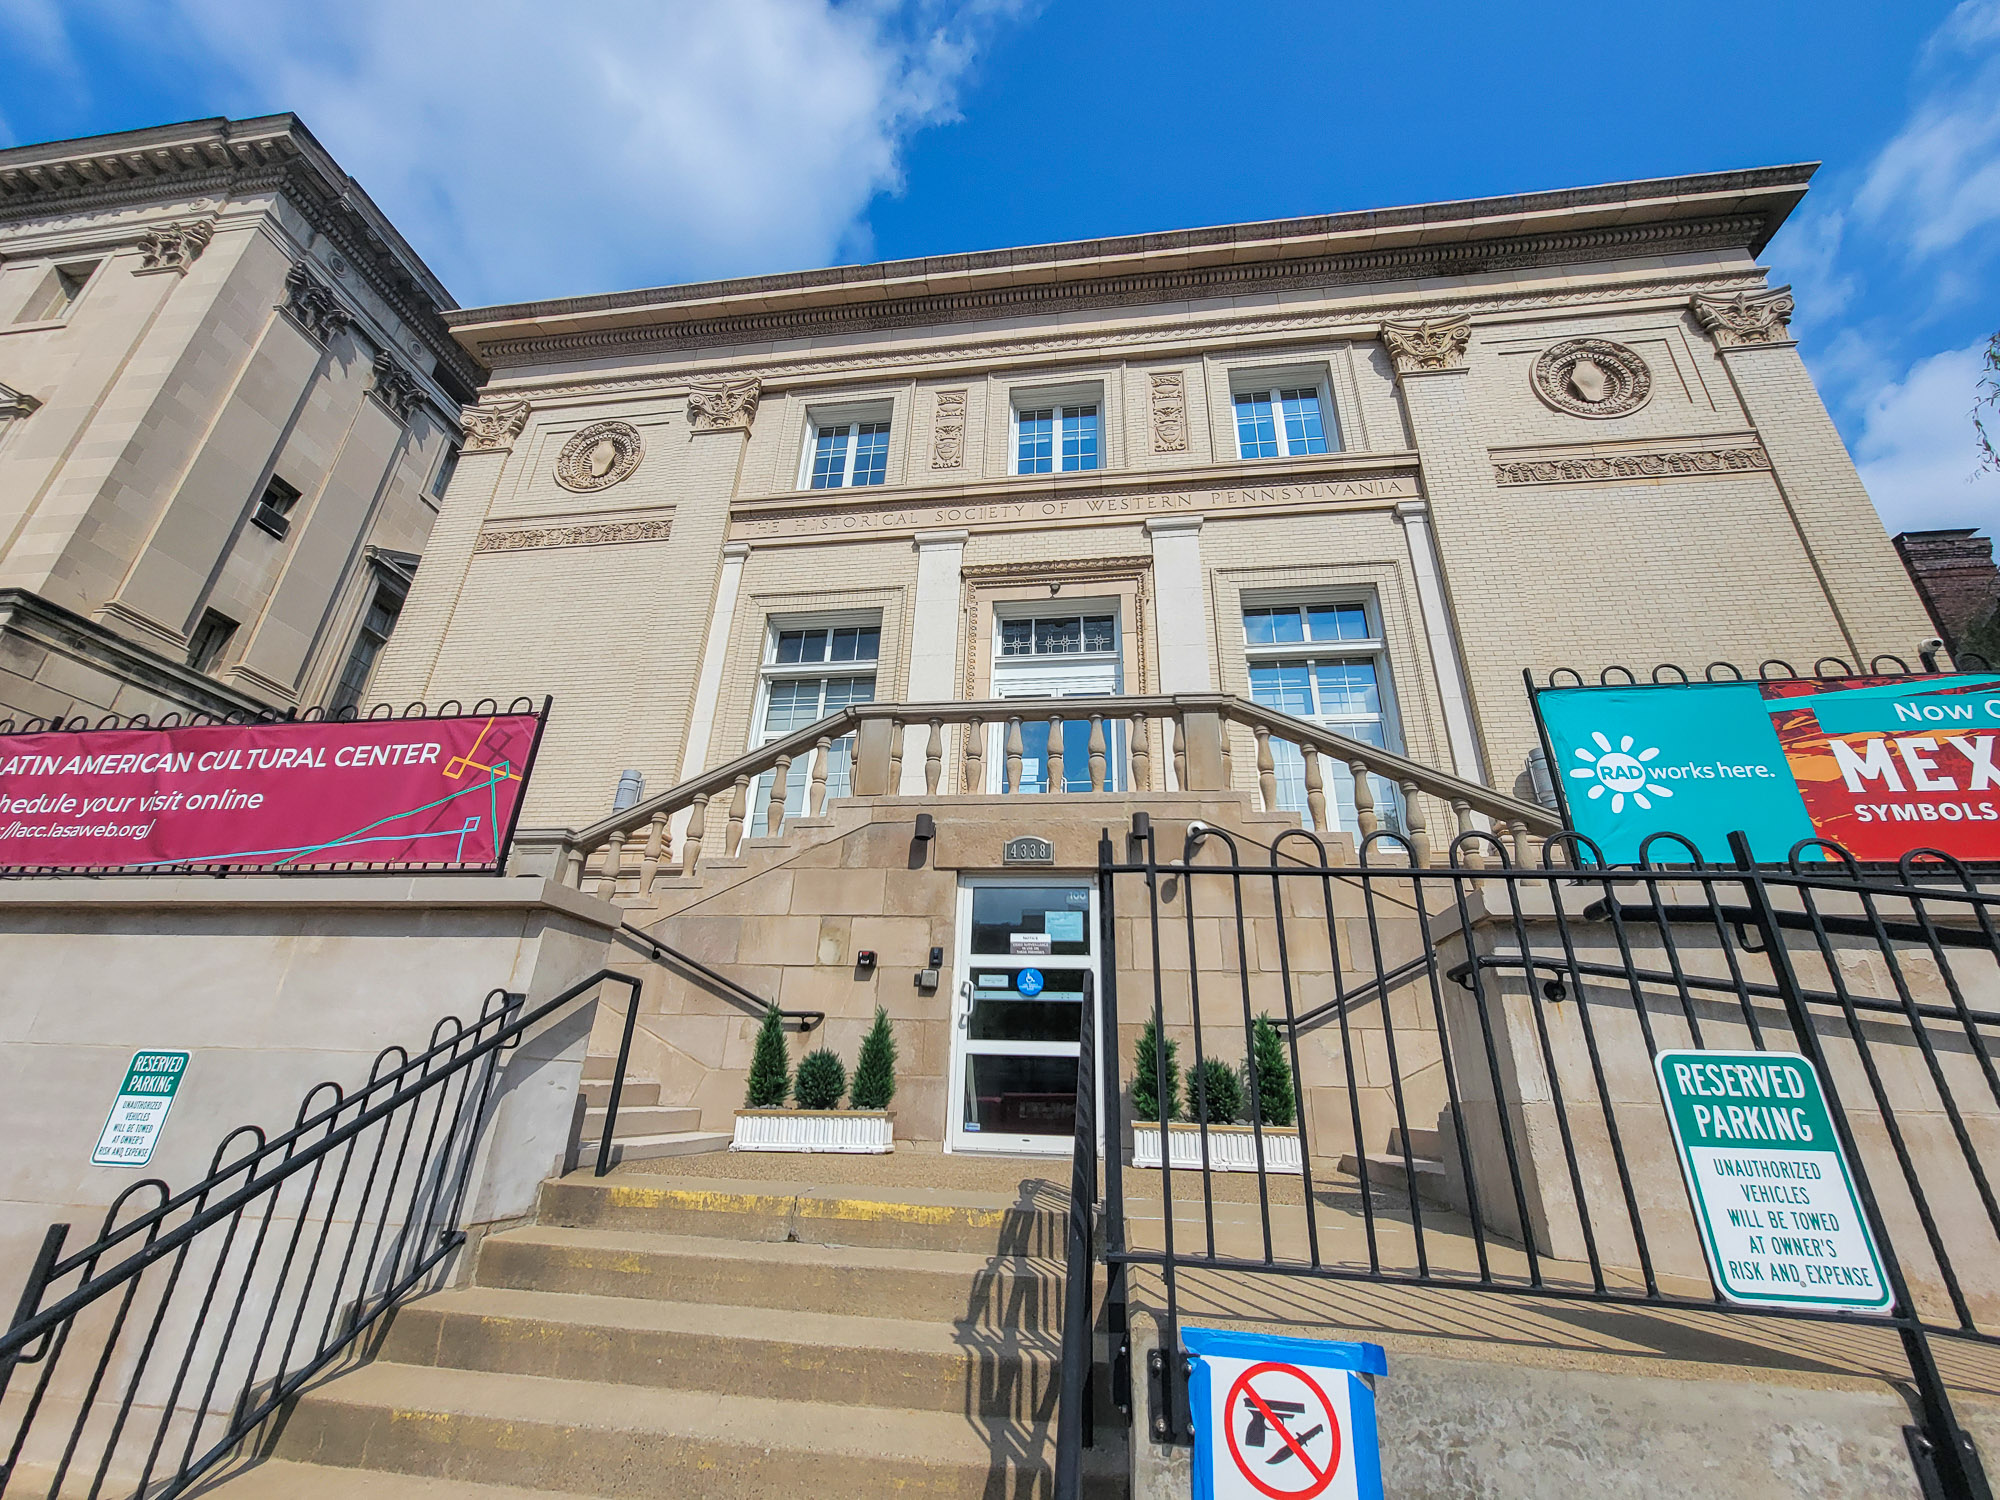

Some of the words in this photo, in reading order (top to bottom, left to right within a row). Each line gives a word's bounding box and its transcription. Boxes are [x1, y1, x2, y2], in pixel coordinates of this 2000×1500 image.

[744, 521, 780, 535] THE
[794, 513, 918, 532] HISTORICAL
[934, 504, 1027, 522] SOCIETY
[1041, 502, 1070, 516] OF
[1085, 494, 1193, 512] WESTERN
[1211, 481, 1404, 505] PENNSYLVANIA
[59, 752, 195, 775] AMERICAN
[197, 747, 327, 772] CULTURAL
[334, 742, 441, 768] CENTER
[1827, 735, 2000, 793] MEX
[1599, 765, 1643, 780] RAD
[1647, 761, 1716, 780] works
[1716, 761, 1776, 779] here.
[75, 796, 136, 818] your
[138, 789, 185, 813] visit
[185, 788, 264, 811] online
[1854, 802, 1999, 822] SYMBOLS
[1010, 843, 1046, 858] 4338
[1069, 891, 1087, 900] 100
[132, 1055, 185, 1073] RESERVED
[127, 1075, 175, 1093] PARKING
[1673, 1063, 1806, 1099] RESERVED
[122, 1100, 162, 1110] UNAUTHORIZED
[125, 1112, 151, 1122] VEHICLES
[1692, 1104, 1814, 1142] PARKING
[126, 1123, 135, 1133] BE
[112, 1135, 121, 1144] AT
[98, 1146, 112, 1156] RISK
[112, 1147, 123, 1157] AND
[125, 1147, 150, 1158] EXPENSE
[1712, 1158, 1822, 1180] UNAUTHORIZED
[1740, 1183, 1811, 1205] VEHICLES
[1727, 1208, 1764, 1229] WILL
[1768, 1210, 1786, 1230] BE
[1790, 1212, 1840, 1232] TOWED
[1749, 1235, 1767, 1255] AT
[1771, 1236, 1837, 1258] OWNER'S
[1728, 1260, 1765, 1281] RISK
[1770, 1262, 1800, 1283] AND
[1806, 1264, 1874, 1288] EXPENSE
